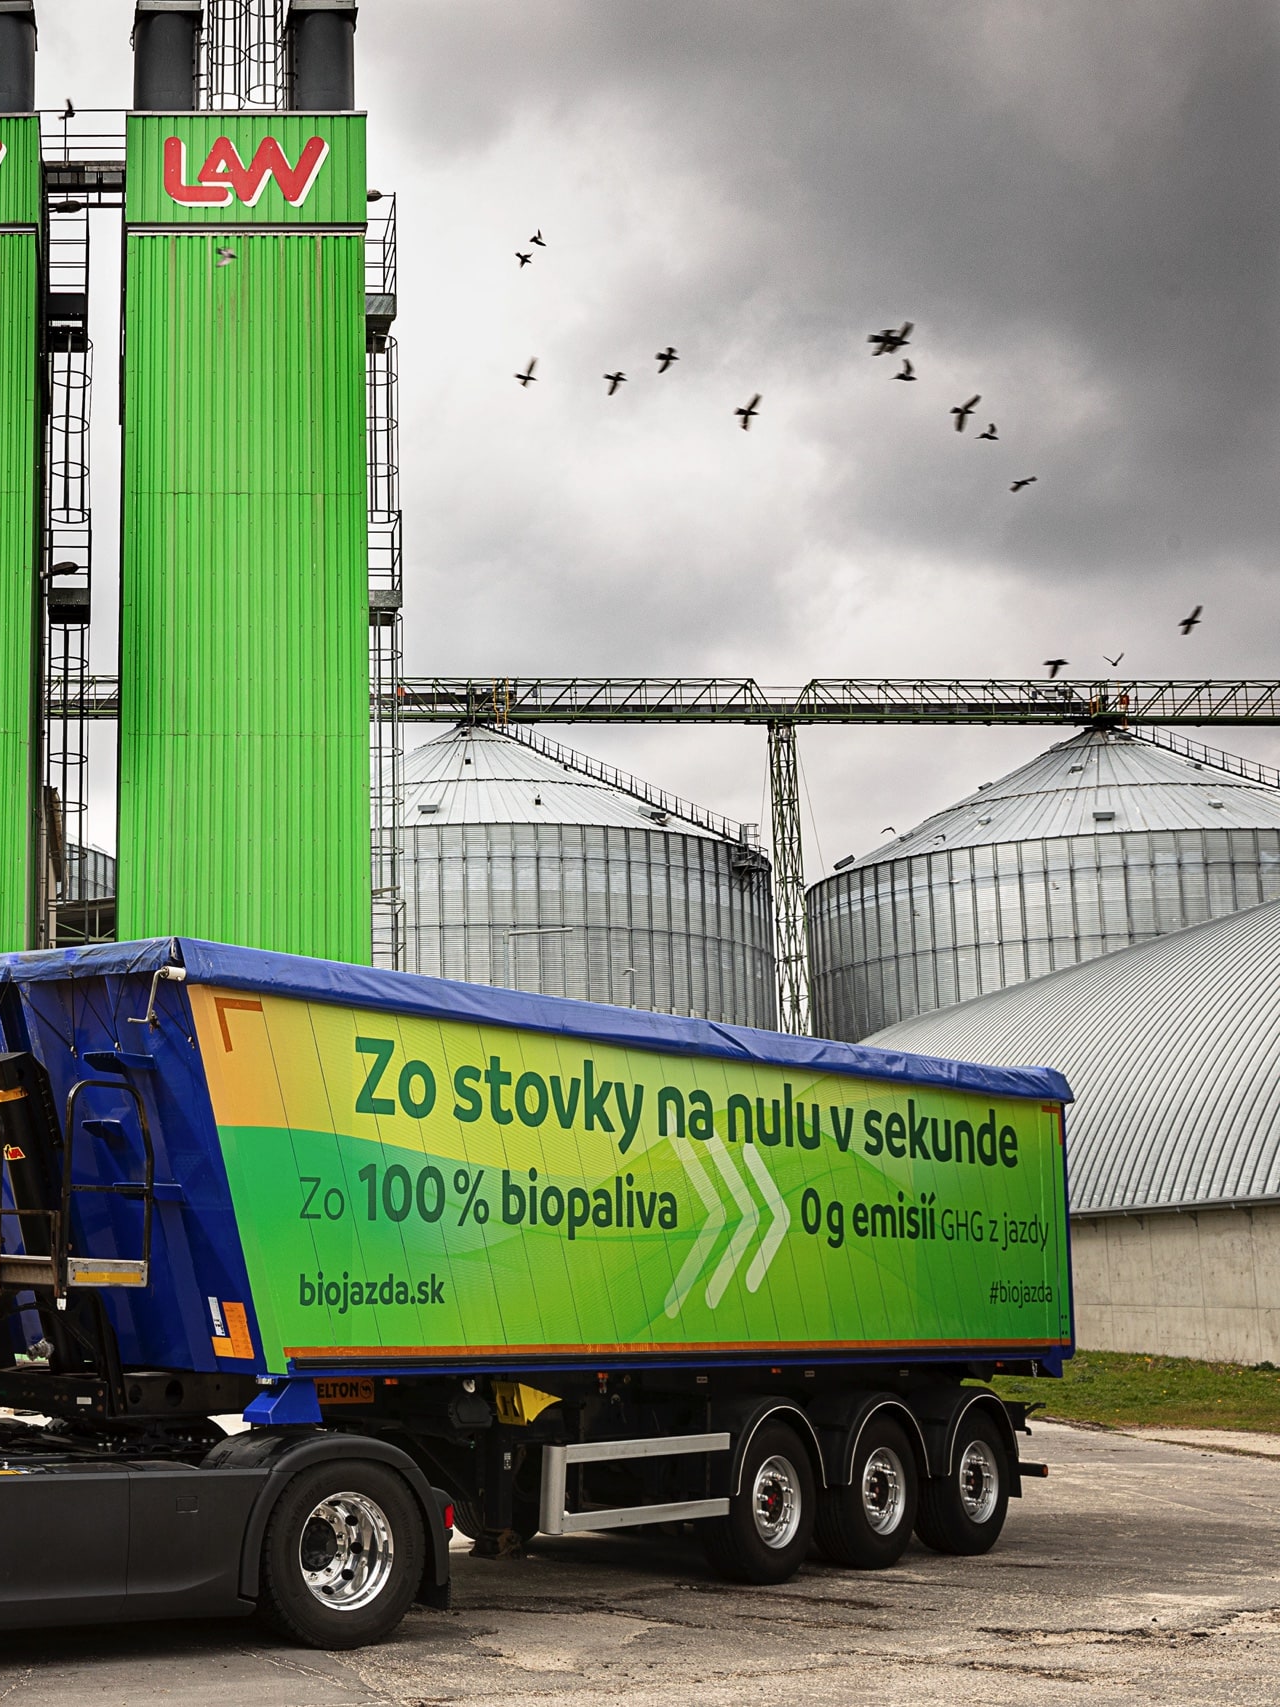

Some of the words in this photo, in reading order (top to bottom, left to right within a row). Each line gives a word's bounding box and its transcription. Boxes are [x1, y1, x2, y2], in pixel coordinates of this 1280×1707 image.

[164, 136, 329, 208] LAW
[355, 1036, 437, 1119] Zo
[453, 1055, 644, 1155] stovky
[658, 1085, 713, 1141] na
[727, 1083, 820, 1151] nulu
[830, 1105, 854, 1153] v
[864, 1099, 1018, 1168] sekunde
[299, 1177, 345, 1220] Zo
[502, 1167, 678, 1241] biopaliva
[801, 1187, 821, 1235] 0
[826, 1201, 844, 1249] g
[852, 1191, 936, 1240] emisií
[941, 1208, 984, 1242] GHG
[989, 1218, 999, 1242] z
[1001, 1212, 1049, 1252] jazdy
[299, 1271, 445, 1314] biojazda.sk
[989, 1280, 1053, 1308] #biojazda
[317, 1382, 360, 1399] ELTON
